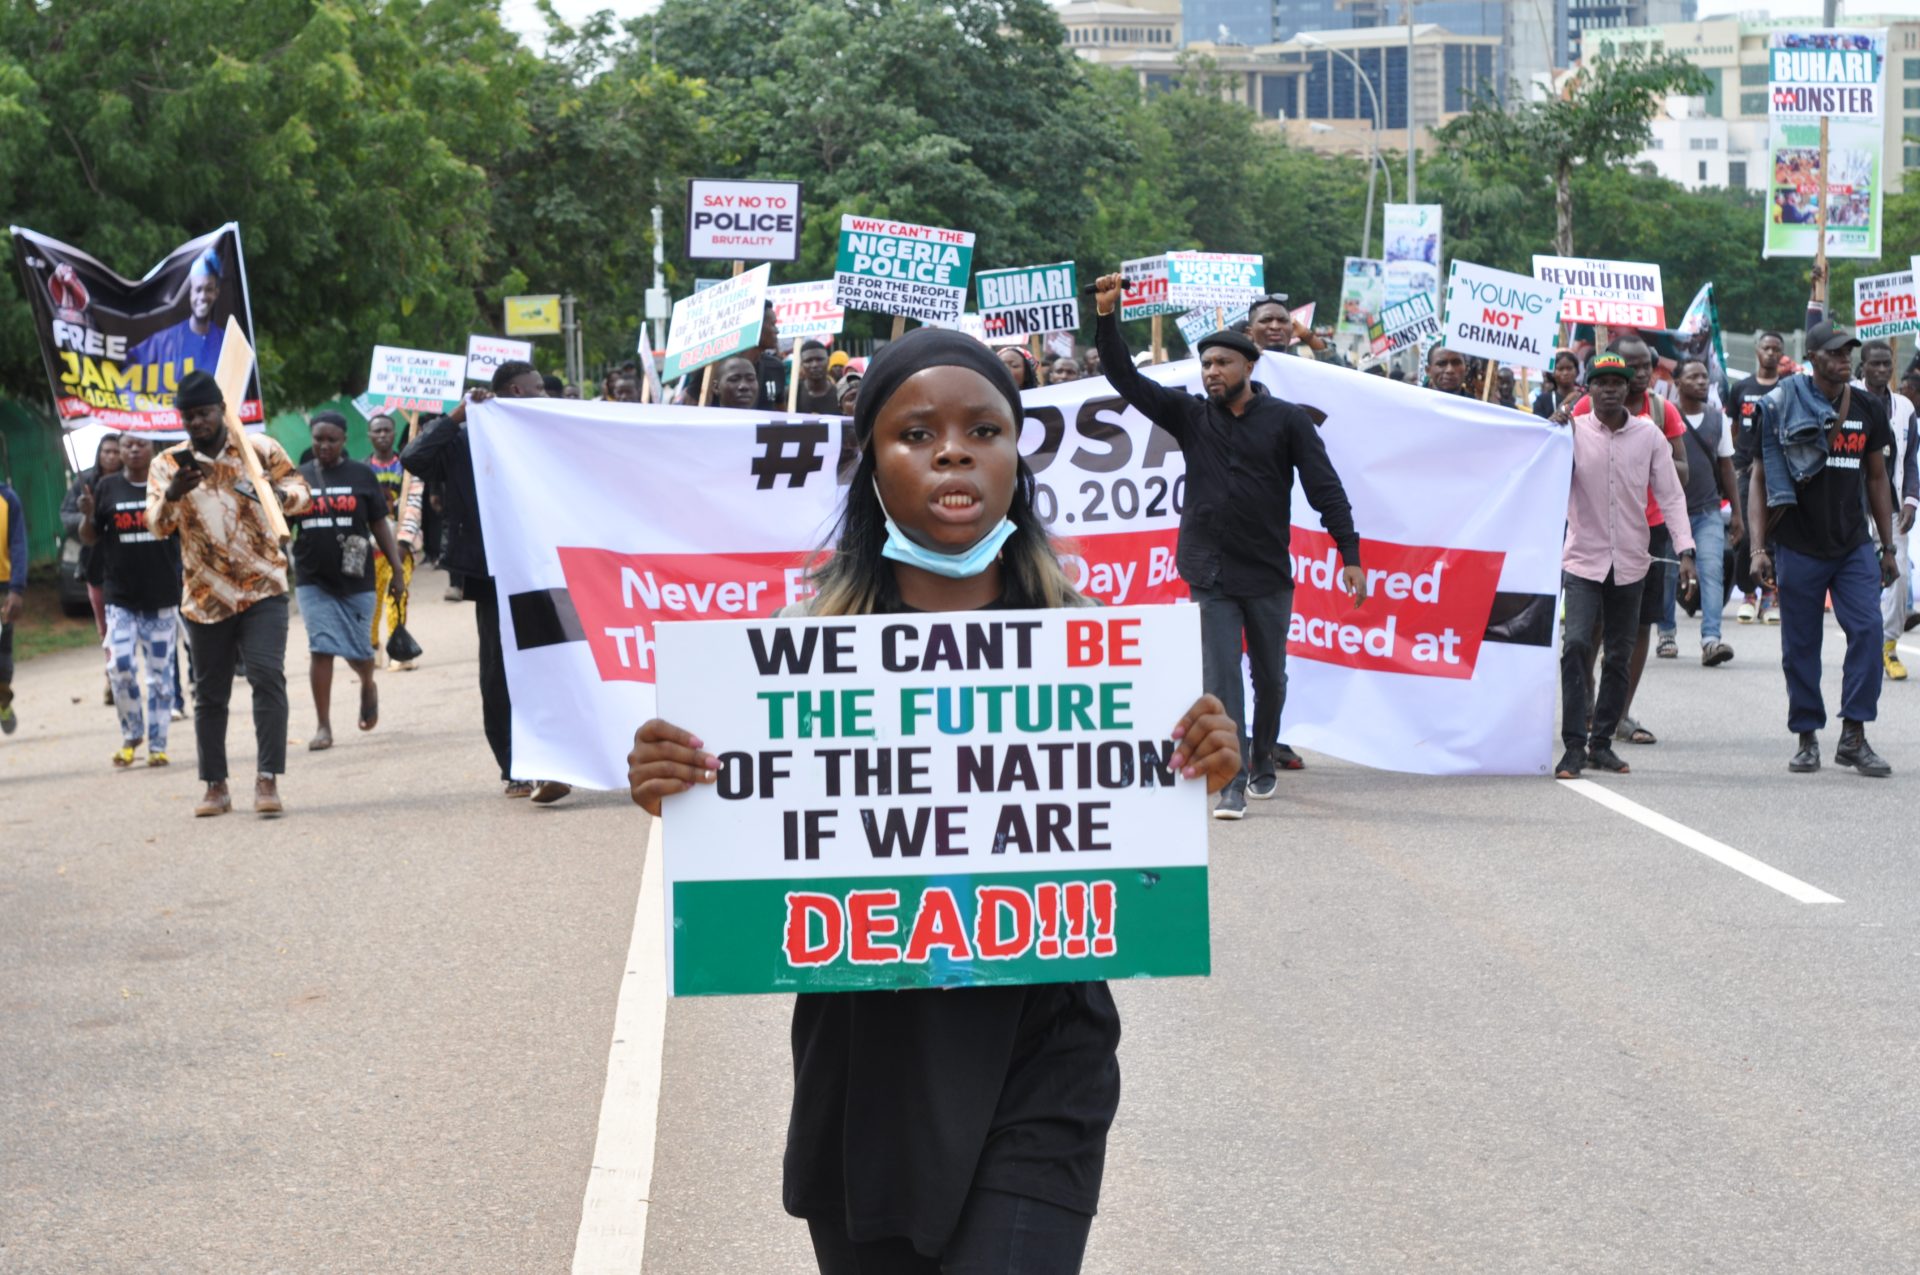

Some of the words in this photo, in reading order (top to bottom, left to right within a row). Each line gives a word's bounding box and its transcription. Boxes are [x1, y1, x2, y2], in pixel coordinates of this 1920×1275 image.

[1775, 51, 1873, 82] BUHARI
[1775, 87, 1873, 113] MONSTER
[704, 195, 734, 207] SAY
[738, 196, 761, 208] NO
[766, 197, 786, 209] TO
[694, 212, 793, 232] POLICE
[852, 219, 885, 233] WHY
[889, 224, 932, 238] CAN'T
[937, 230, 964, 243] THE
[712, 235, 774, 245] BRUTALITY
[848, 233, 960, 267] NIGERIA
[853, 254, 950, 285] POLICE
[1174, 261, 1257, 276] NIGERIA
[1586, 262, 1610, 270] THE
[839, 275, 855, 286] BE
[857, 278, 883, 290] FOR
[886, 281, 910, 293] THE
[912, 285, 960, 299] PEOPLE
[981, 268, 1072, 308] BUHARI
[1180, 272, 1252, 286] POLICE
[1541, 267, 1655, 292] REVOLUTION
[837, 286, 862, 297] FOR
[864, 289, 898, 302] ONCE
[901, 293, 937, 307] SINCE
[940, 298, 959, 310] ITS
[1593, 289, 1621, 299] NOT
[1628, 292, 1645, 300] BE
[1860, 292, 1915, 317] crim
[717, 295, 757, 320] NATION
[775, 298, 836, 318] rime
[835, 297, 959, 322] ESTABLISHMENT?
[1482, 308, 1524, 330] NOT
[1562, 300, 1658, 327] ELEVISED
[985, 303, 1074, 338] MONSTER
[1860, 319, 1919, 339] NIGERIAN
[53, 319, 127, 360] FREE
[1458, 323, 1540, 355] CRIMINAL
[60, 352, 194, 393] JAMIU
[385, 355, 402, 363] WE
[408, 356, 434, 366] CANT
[386, 365, 404, 374] THE
[409, 366, 448, 377] FUTURE
[377, 373, 388, 382] OF
[395, 375, 412, 384] THE
[418, 378, 456, 388] NATION
[387, 384, 395, 392] IF
[401, 384, 418, 394] WE
[423, 387, 442, 396] ARE
[621, 566, 767, 613] Never
[1056, 553, 1137, 605] Day
[747, 626, 857, 675] WE
[881, 622, 1042, 672] CANT
[1066, 618, 1142, 668] BE
[1287, 612, 1397, 658] acred
[1411, 628, 1461, 664] at
[757, 688, 876, 739] THE
[900, 682, 1133, 735] FUTURE
[716, 750, 793, 800] OF
[814, 746, 931, 797] THE
[956, 739, 1176, 794] NATION
[783, 809, 838, 861] IF
[860, 805, 969, 859] WE
[991, 801, 1111, 854] ARE
[781, 880, 1118, 967] DEAD!!!
